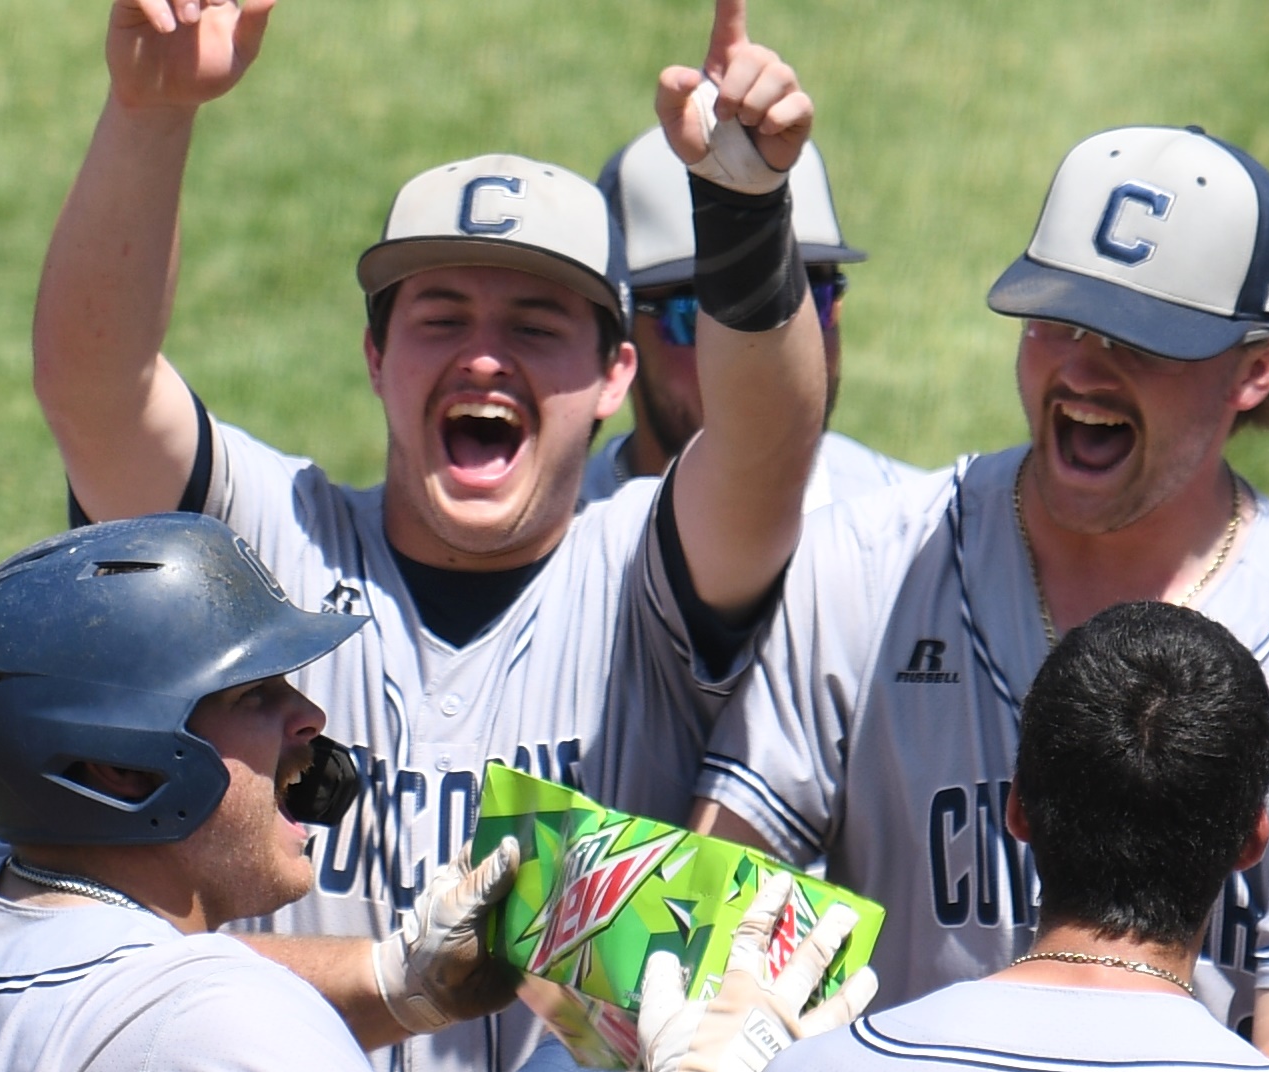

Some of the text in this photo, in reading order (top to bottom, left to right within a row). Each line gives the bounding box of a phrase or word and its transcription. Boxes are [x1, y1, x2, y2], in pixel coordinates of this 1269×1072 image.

[459, 175, 526, 238] C
[1092, 179, 1176, 267] C
[895, 671, 961, 684] RUSSELL
